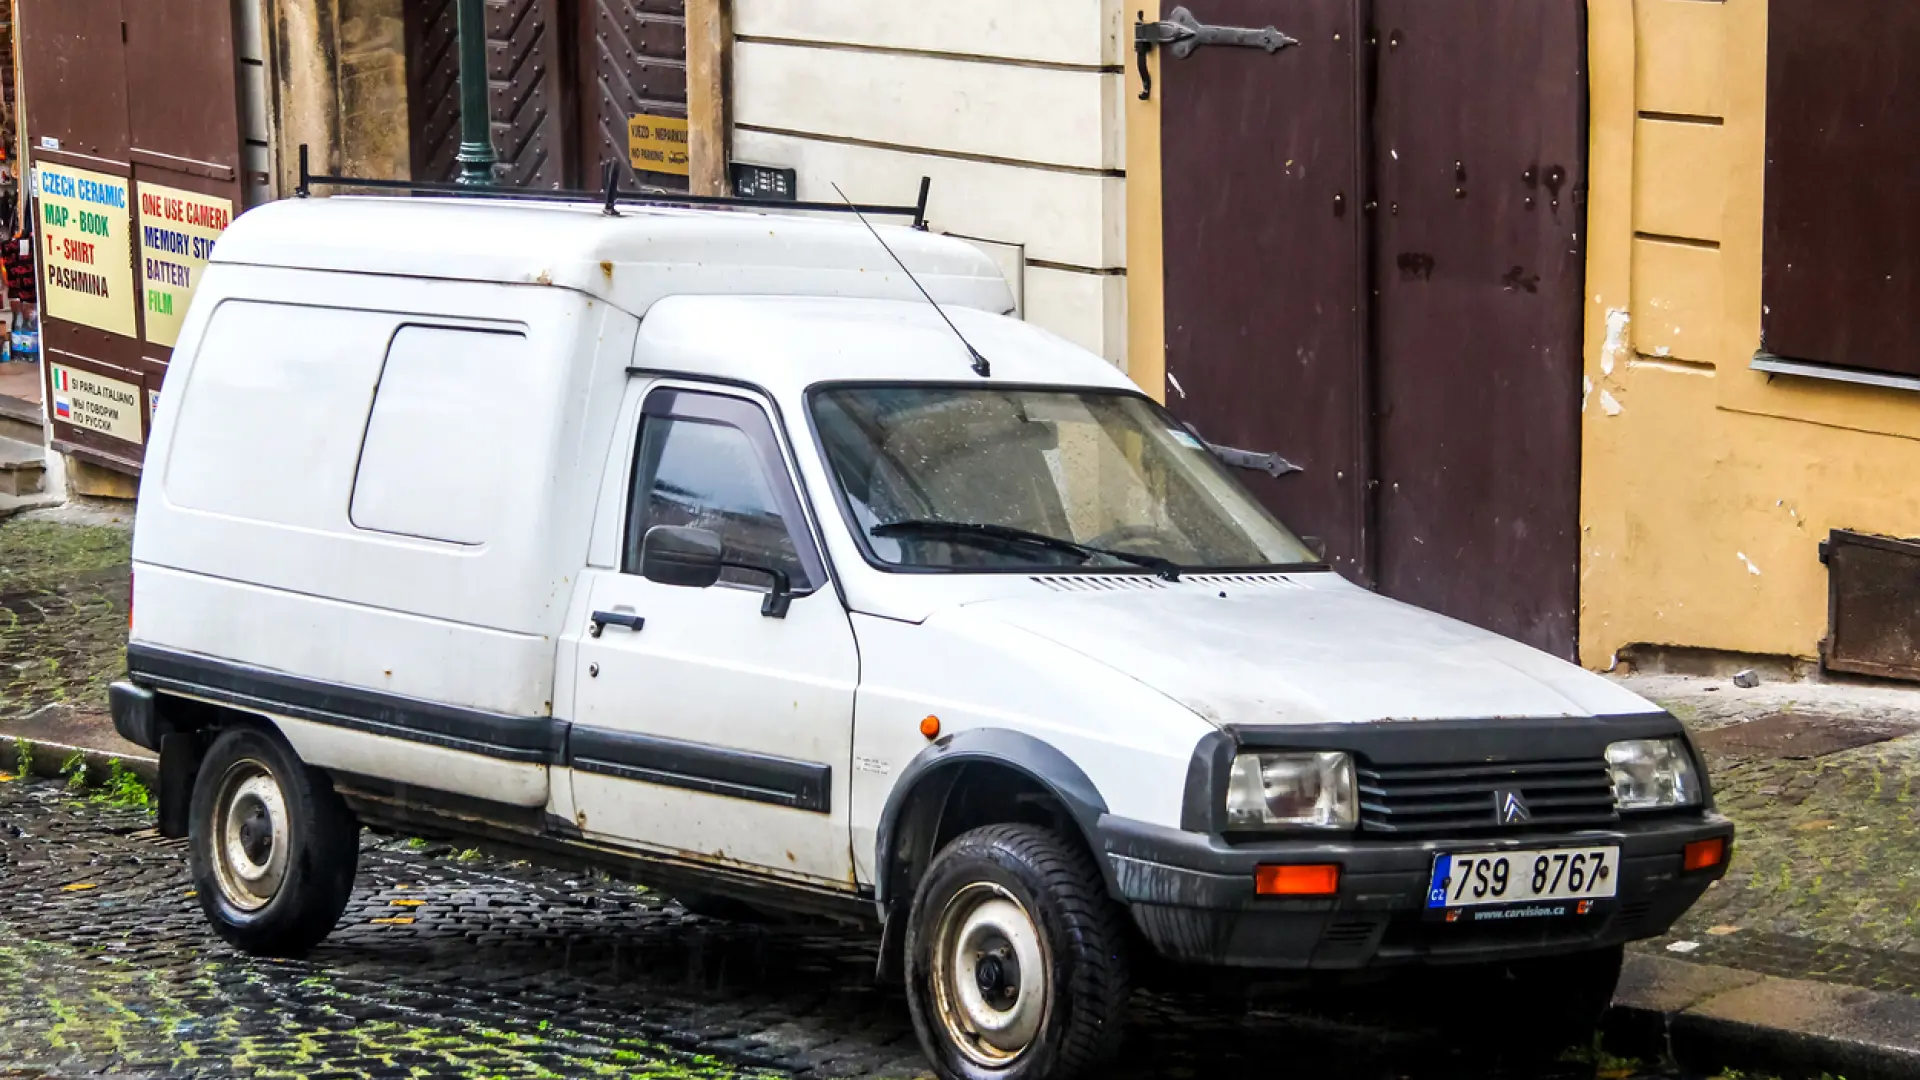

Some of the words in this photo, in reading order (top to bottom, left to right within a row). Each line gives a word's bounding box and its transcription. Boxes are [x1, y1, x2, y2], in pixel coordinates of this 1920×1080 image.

[631, 148, 640, 159] NO
[641, 149, 664, 162] PARKING
[42, 171, 76, 198] CZECH
[78, 178, 125, 209] CERAMIC
[44, 202, 69, 228] MAP
[80, 210, 109, 237] BOOK
[142, 193, 162, 217] ONE
[163, 197, 184, 222] USE
[186, 201, 229, 231] CAMERA
[46, 234, 53, 256] T
[63, 237, 95, 265] SHIRT
[144, 226, 190, 255] MEMORY
[48, 264, 109, 298] PASHMINA
[147, 258, 190, 288] BATTERY
[148, 289, 173, 315] FILM
[72, 378, 78, 389] SI
[80, 380, 101, 397] PARLA
[102, 386, 134, 406] ITALIANO
[72, 397, 84, 410] МЫ
[86, 401, 119, 420] ГОВОРИМ
[73, 411, 84, 423] ПО
[86, 414, 112, 431] РУССКИ
[1453, 857, 1510, 901] 7S9
[1531, 852, 1606, 895] 8767
[1431, 888, 1445, 901] CZ
[1474, 905, 1565, 921] www.carvision.cz
